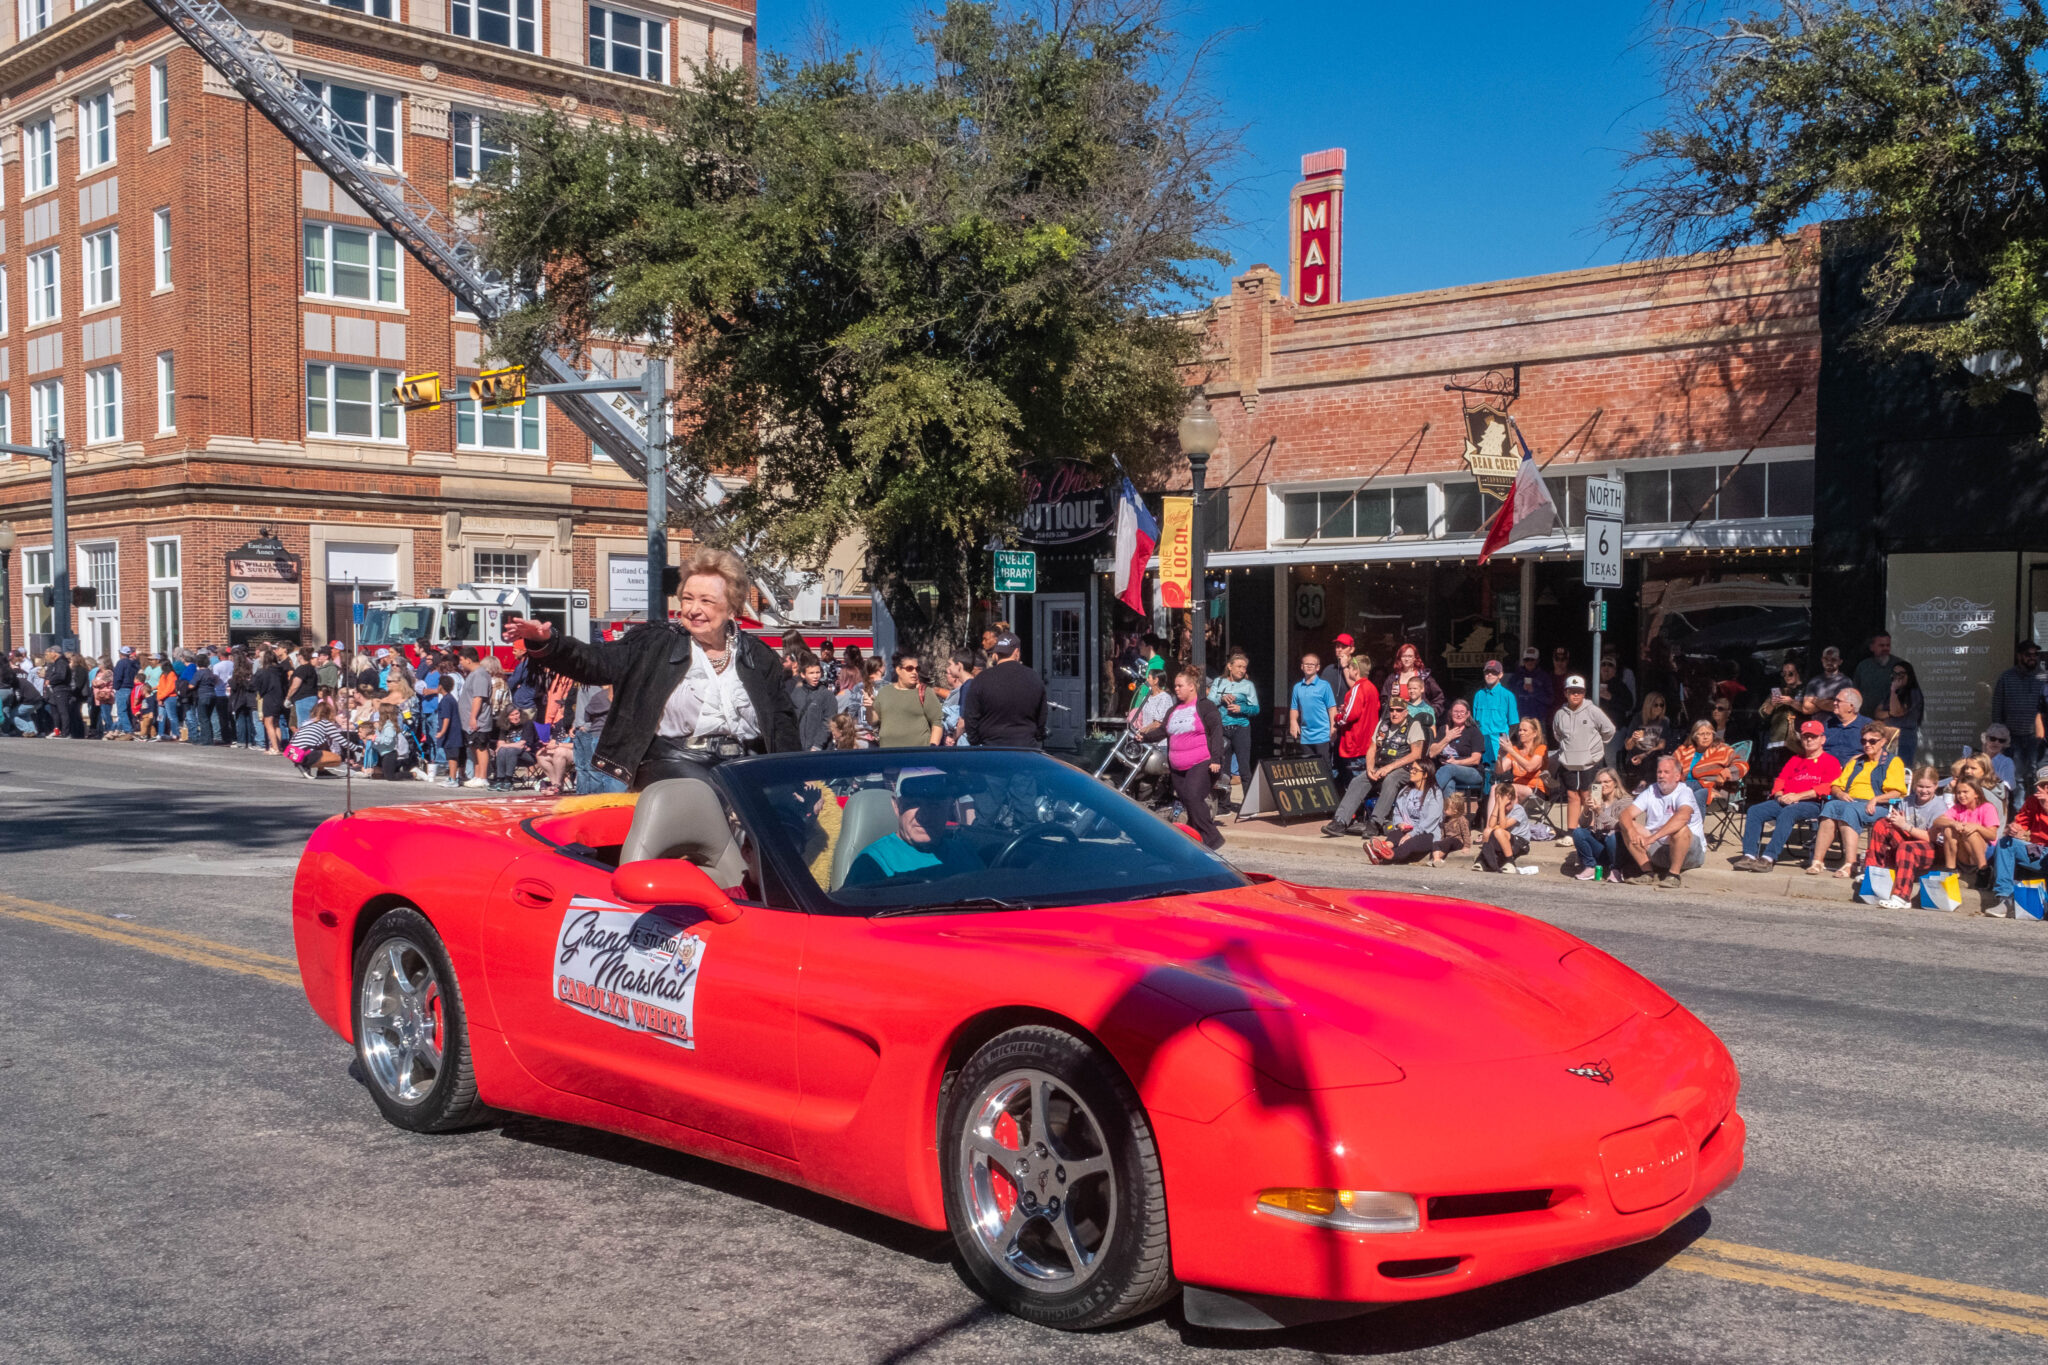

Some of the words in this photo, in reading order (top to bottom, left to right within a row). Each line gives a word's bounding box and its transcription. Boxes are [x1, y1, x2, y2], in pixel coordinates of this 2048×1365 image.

[1303, 200, 1328, 303] MAJ
[1472, 456, 1493, 470] BEAR
[1495, 458, 1519, 471] CREEK
[1589, 485, 1622, 508] NORTH
[1011, 500, 1104, 531] OUTIQUE
[1173, 524, 1188, 578] LOCAL
[1598, 528, 1609, 556] 6
[999, 554, 1031, 565] PUBLIC
[1163, 549, 1172, 578] DINE
[1590, 562, 1617, 577] TEXAS
[611, 566, 637, 575] Eastland
[996, 567, 1033, 578] LIBRARY
[626, 577, 645, 585] Annex
[1299, 593, 1322, 619] 80
[1952, 611, 1994, 621] CENTER
[1916, 646, 1969, 655] APPOINTMENT
[1970, 646, 1990, 655] ONLY
[1271, 763, 1294, 779] BEAR
[1294, 761, 1321, 776] CREEK
[1283, 776, 1317, 787] TAPHOUSE
[1279, 785, 1336, 812] OPEN
[560, 910, 638, 964] Grand
[589, 950, 697, 1000] Marshal
[558, 975, 630, 1022] CAROLYN
[631, 999, 689, 1041] WHITE
[990, 1042, 1043, 1060] MICHELIN
